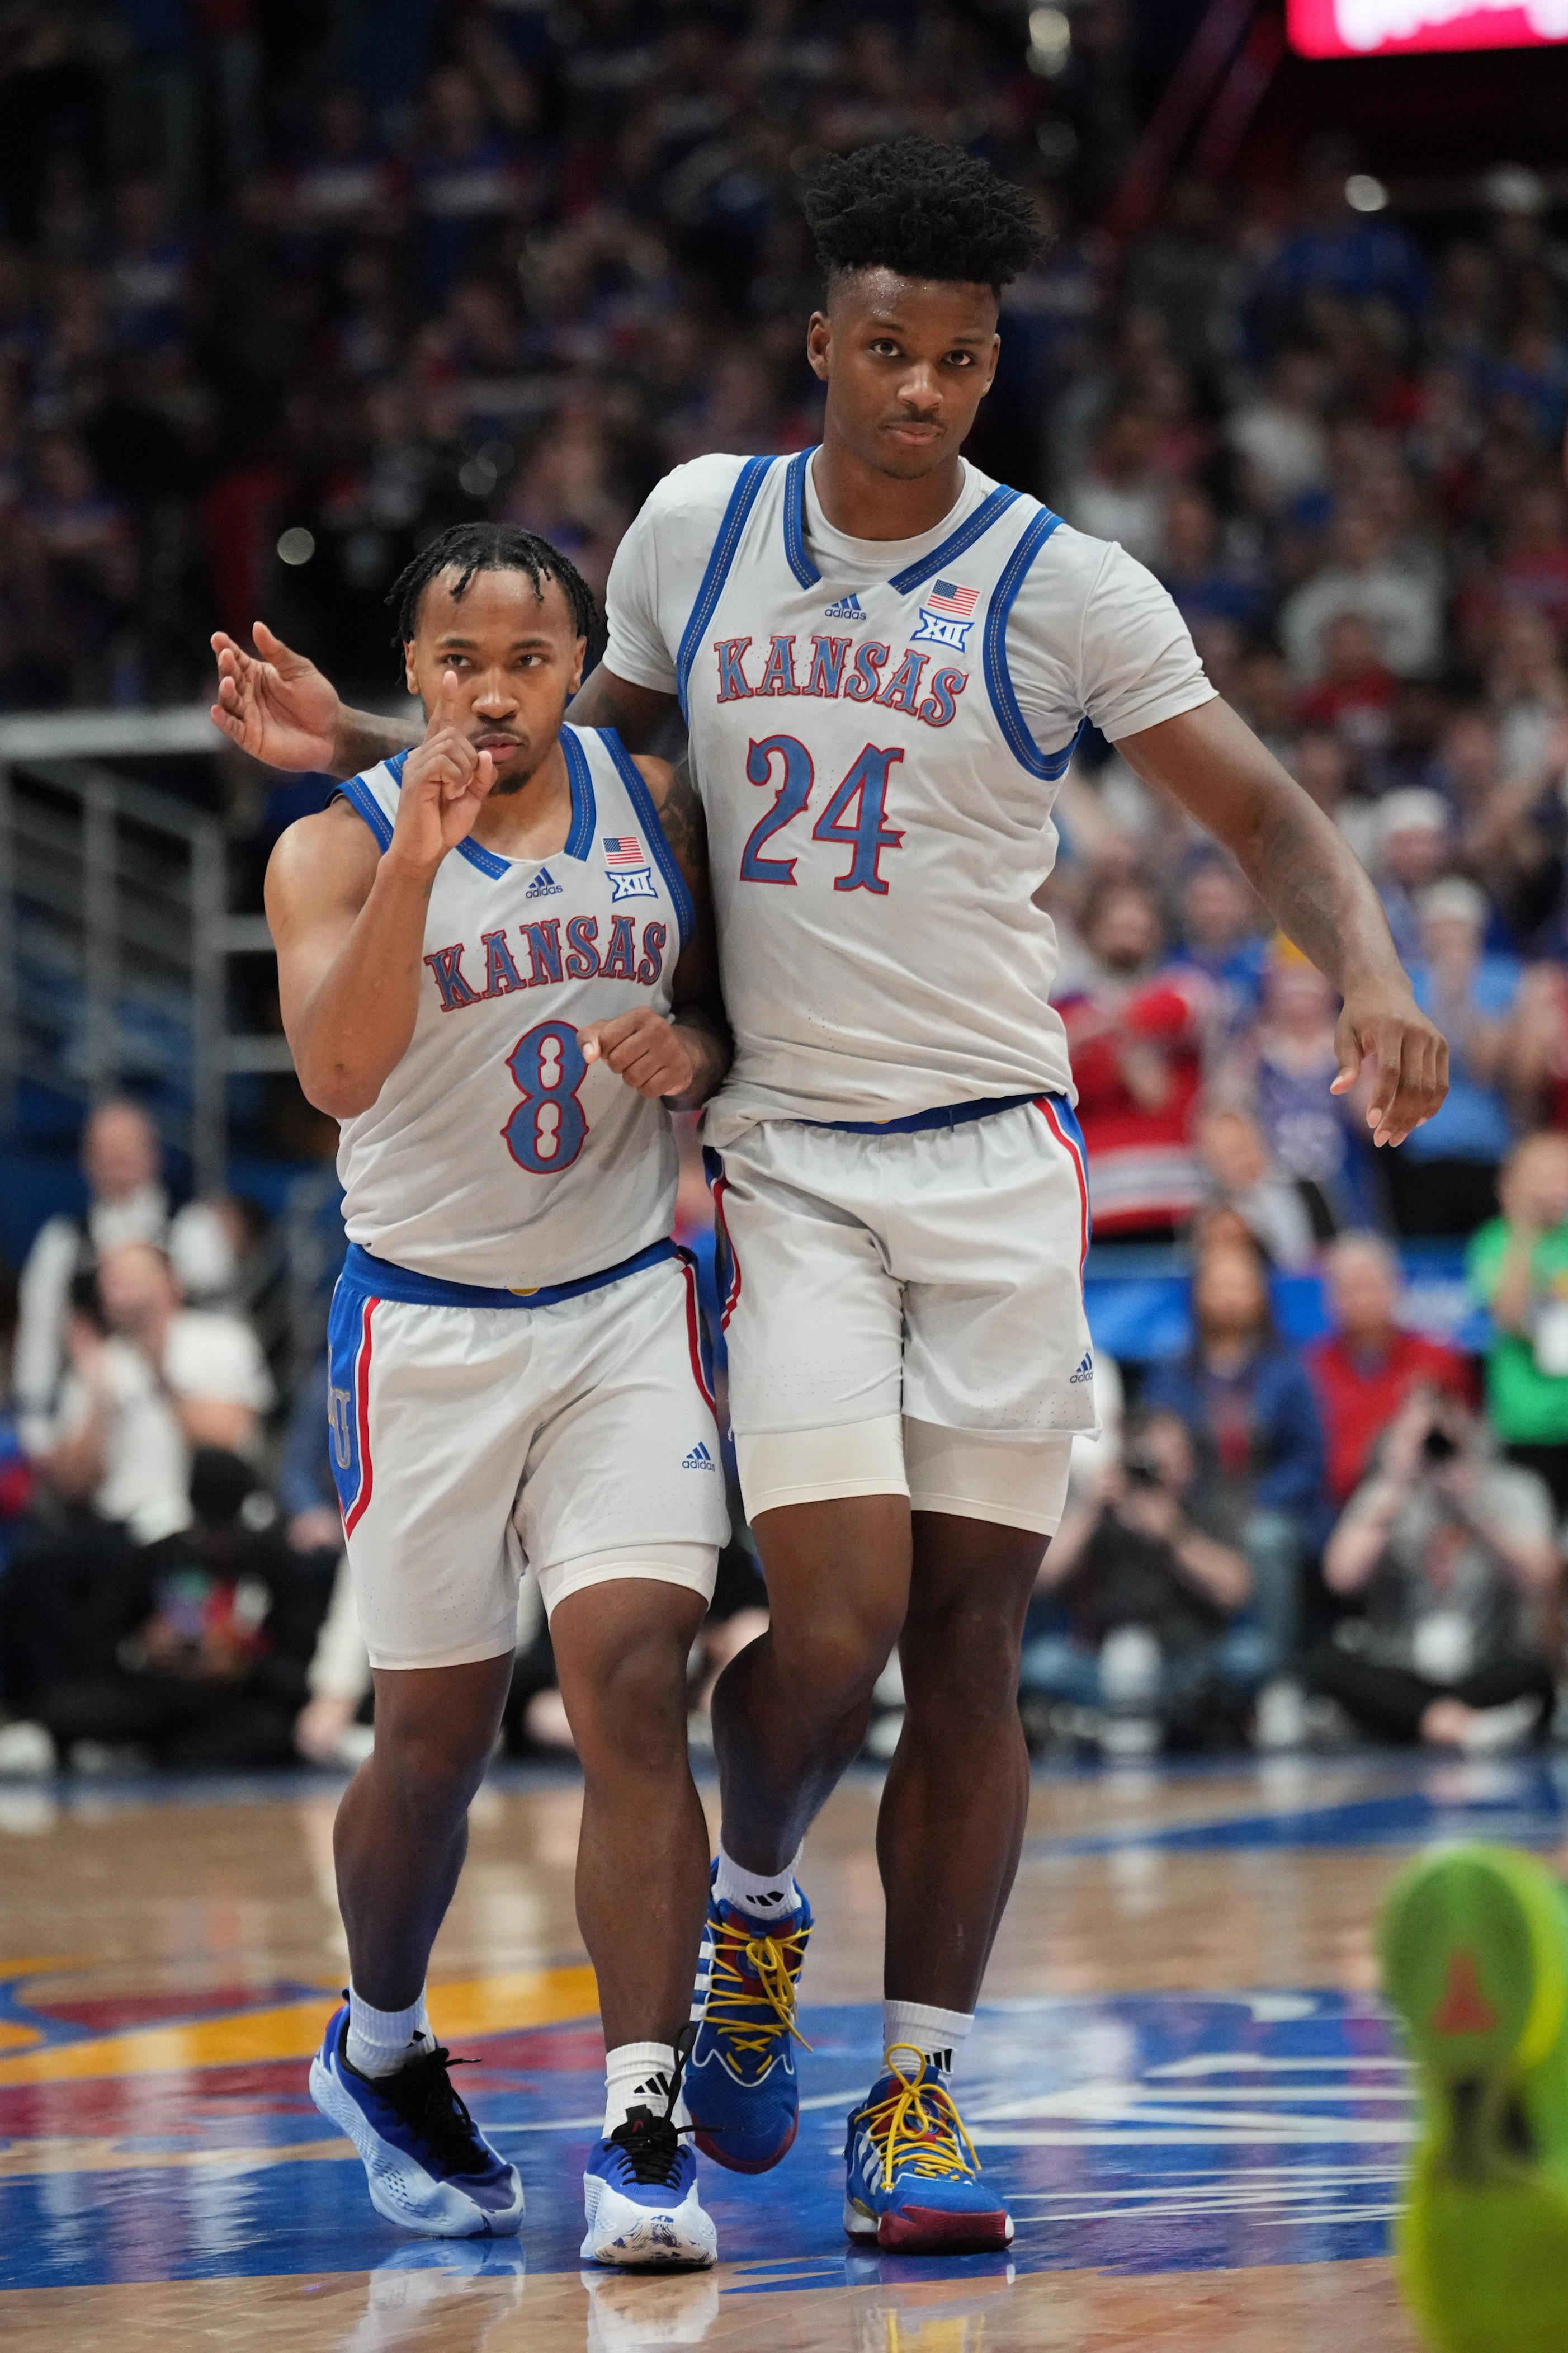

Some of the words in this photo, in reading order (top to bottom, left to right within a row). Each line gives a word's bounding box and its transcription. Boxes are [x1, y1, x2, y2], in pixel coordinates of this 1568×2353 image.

[824, 607, 867, 620] adidas
[714, 635, 969, 727] KANSAS
[740, 734, 906, 895] 24
[525, 884, 563, 899] adidas
[424, 915, 666, 1012] KANSAS
[500, 1021, 589, 1174] 8
[682, 1459, 715, 1472] adidas
